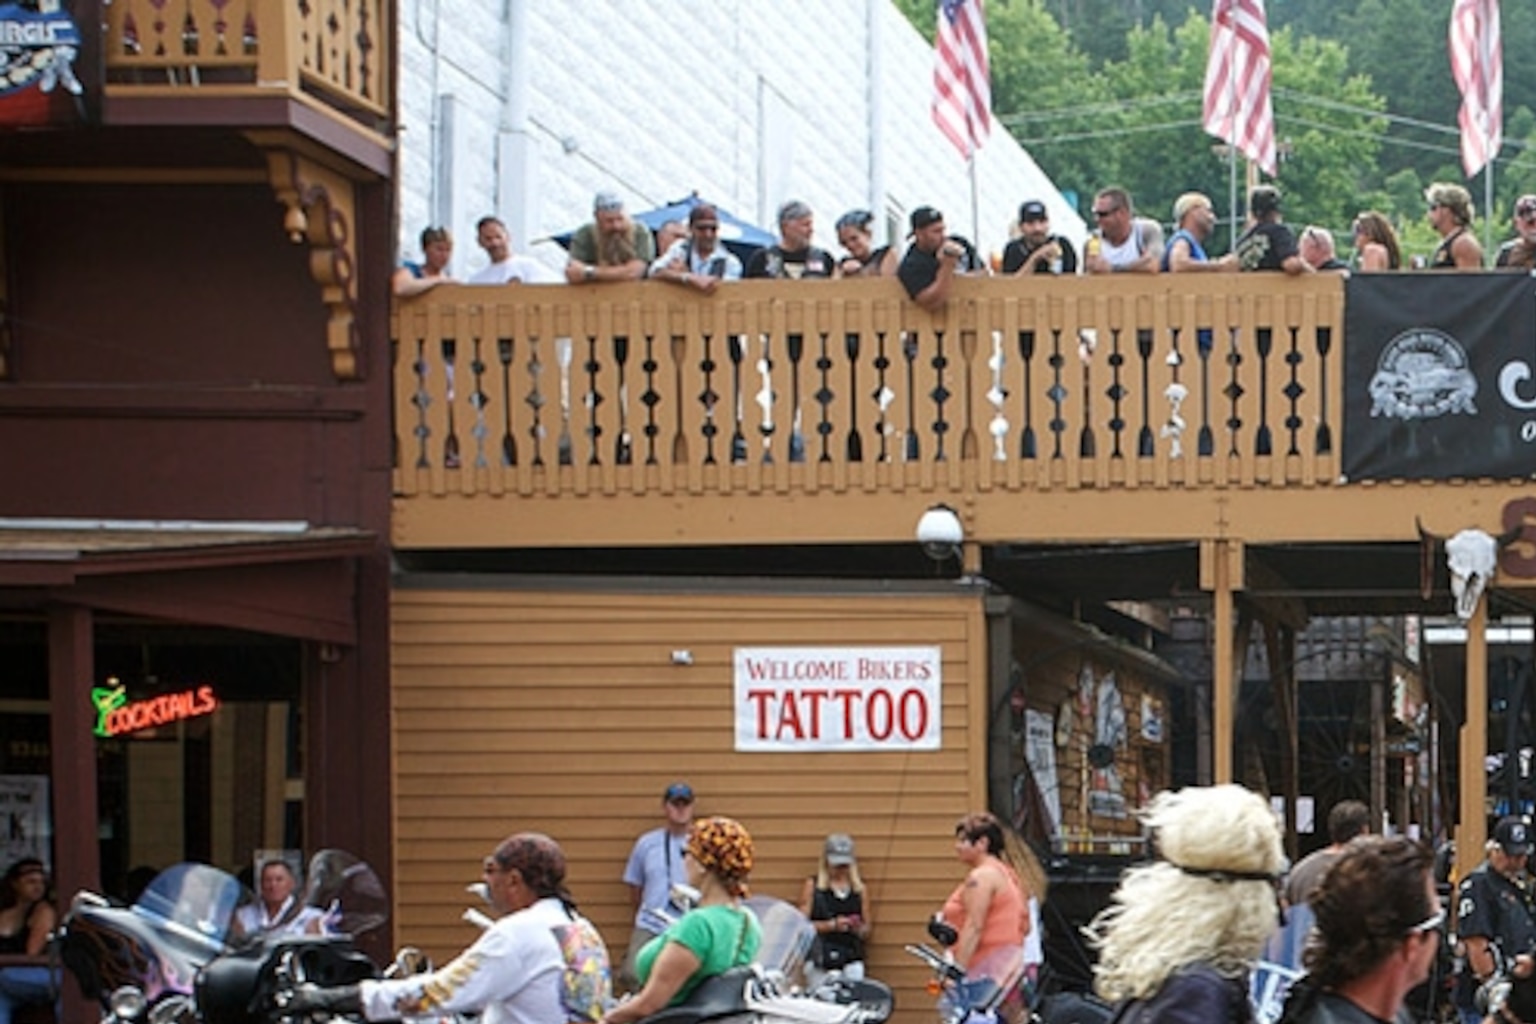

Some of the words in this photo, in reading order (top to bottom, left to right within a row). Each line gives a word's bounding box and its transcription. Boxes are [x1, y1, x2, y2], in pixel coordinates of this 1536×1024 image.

[745, 658, 849, 681] WELCOME
[857, 657, 932, 681] BIKERS
[105, 685, 217, 734] COCKTAILS
[746, 687, 929, 742] TATTOO
